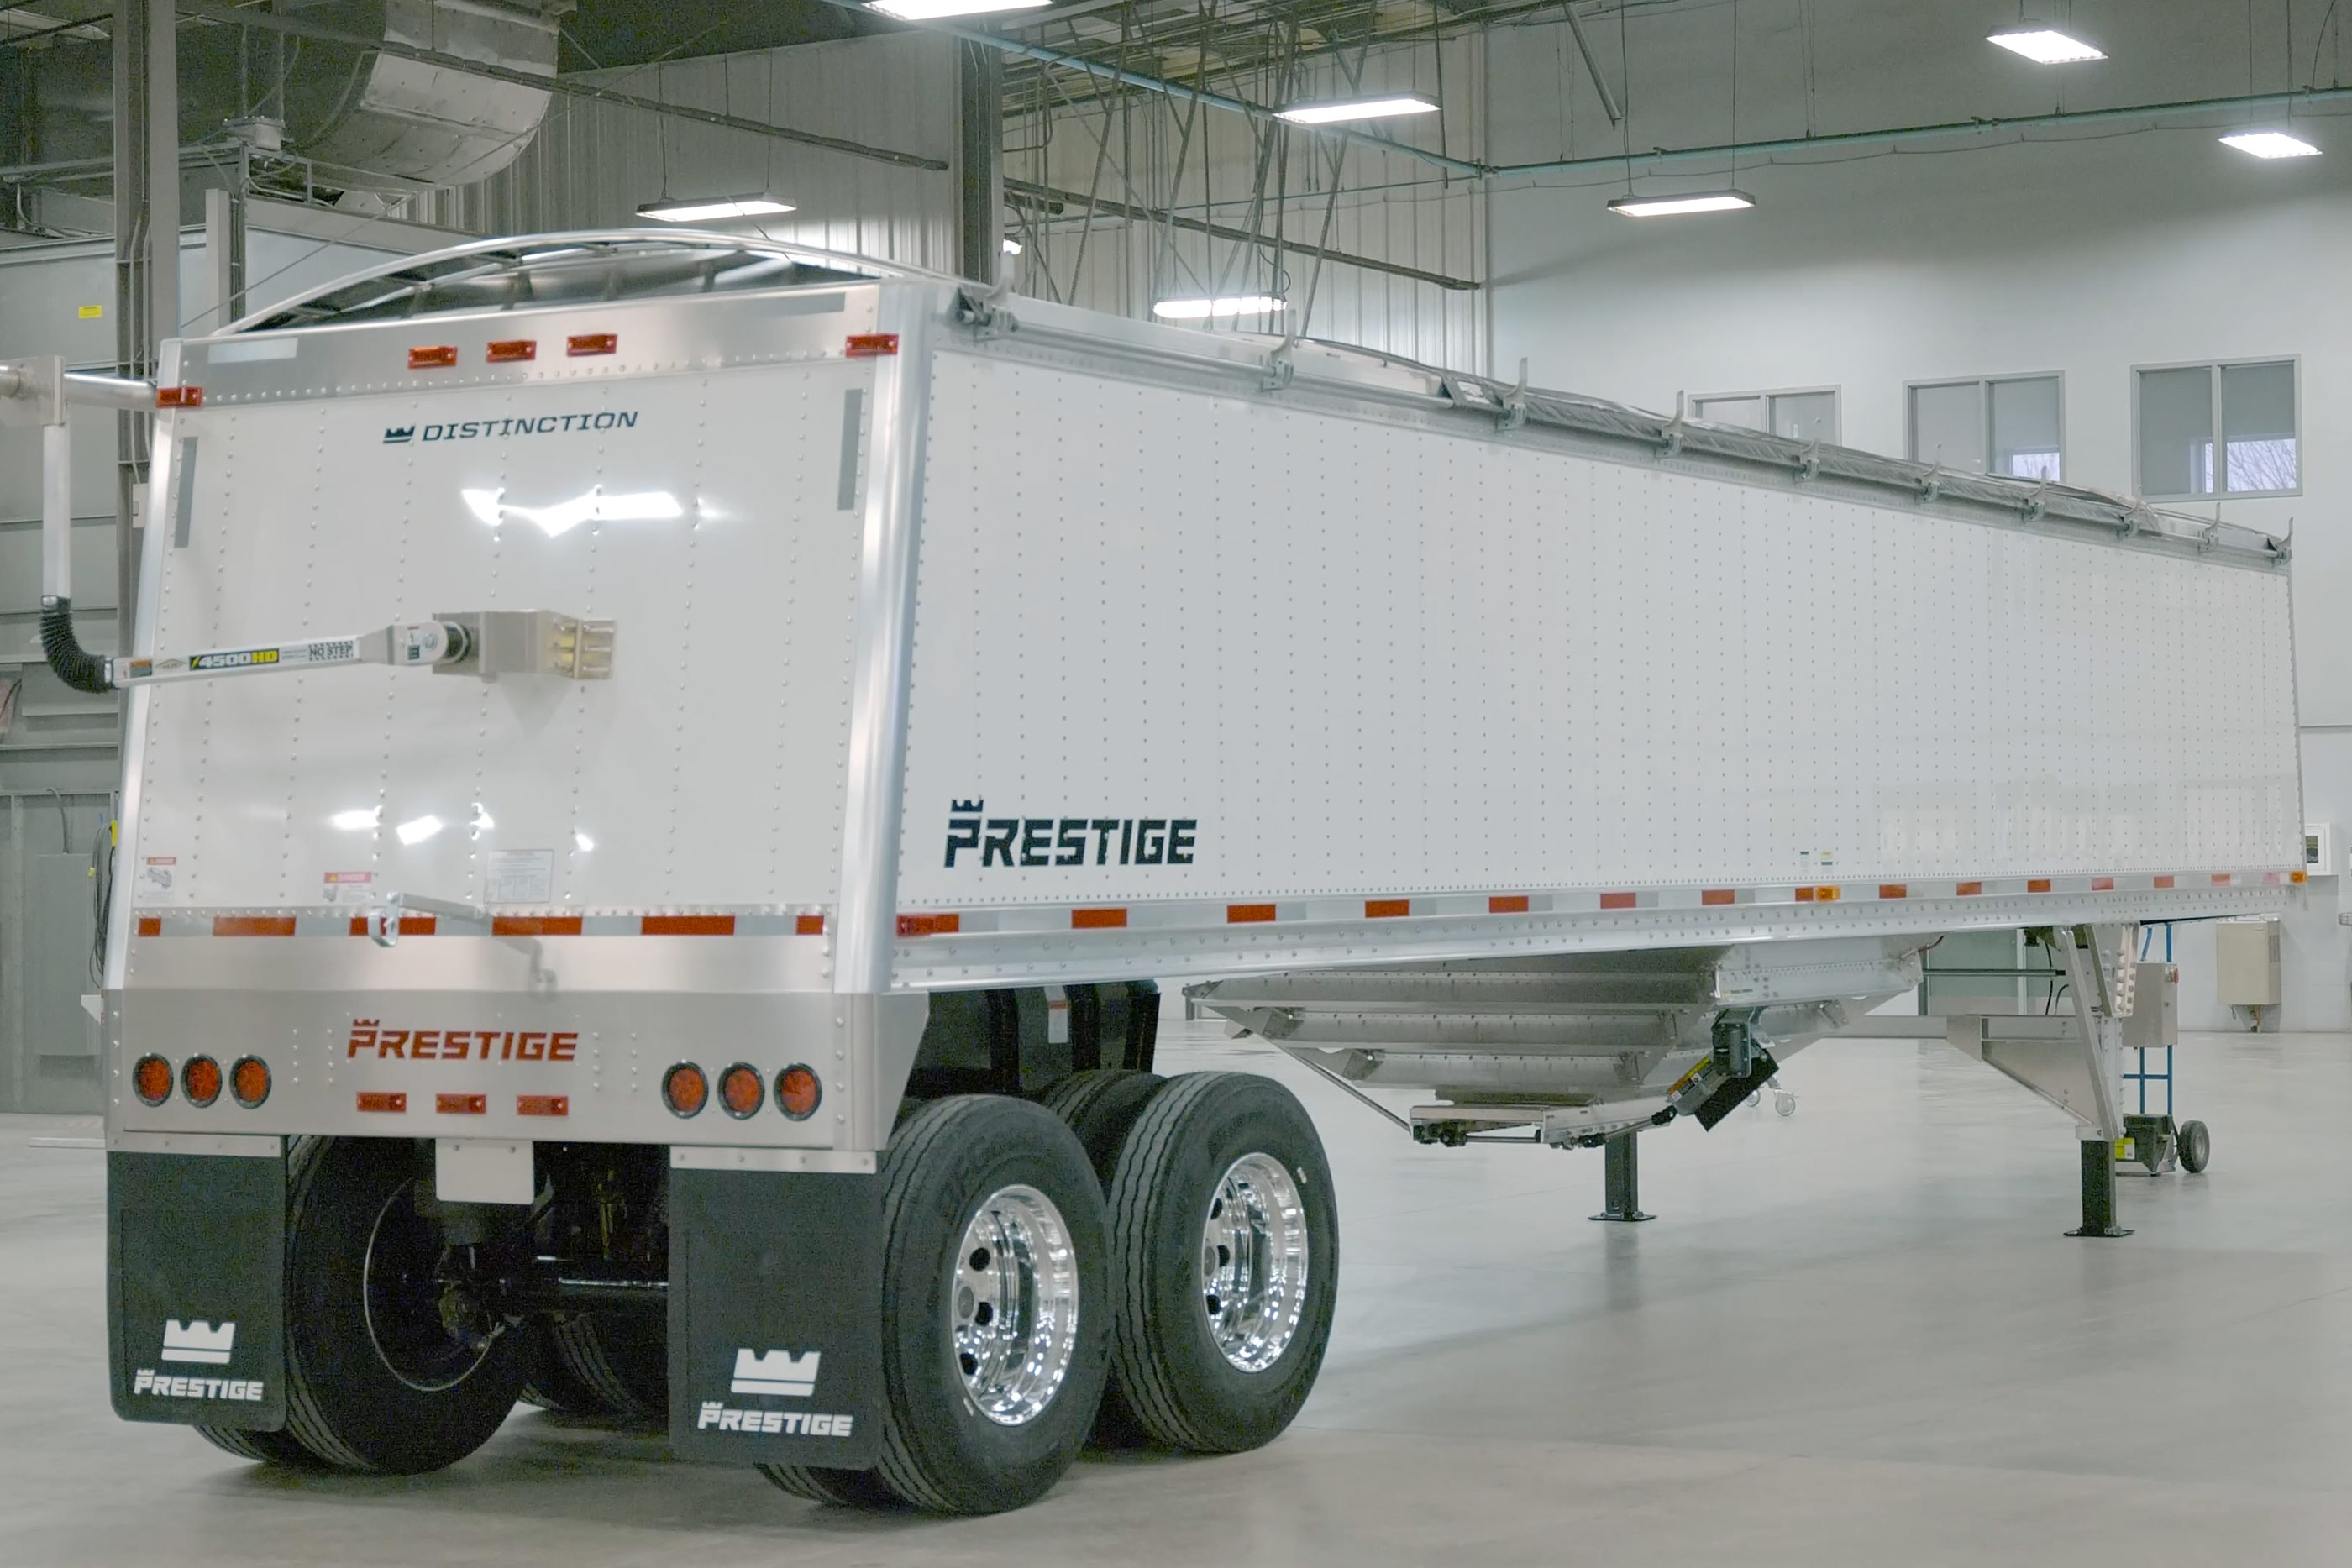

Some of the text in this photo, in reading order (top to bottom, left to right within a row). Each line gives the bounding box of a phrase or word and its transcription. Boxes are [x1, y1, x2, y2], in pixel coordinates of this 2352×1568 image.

[422, 411, 638, 442] DISTINCTION
[198, 650, 278, 669] 4500HD
[309, 647, 325, 657] NO
[327, 645, 353, 655] STEP
[943, 818, 1198, 868] PRESTIGE
[347, 1030, 579, 1062] PRESTIGE
[133, 1373, 265, 1402] PRESTIGE
[697, 1407, 854, 1438] PRESTIGE
